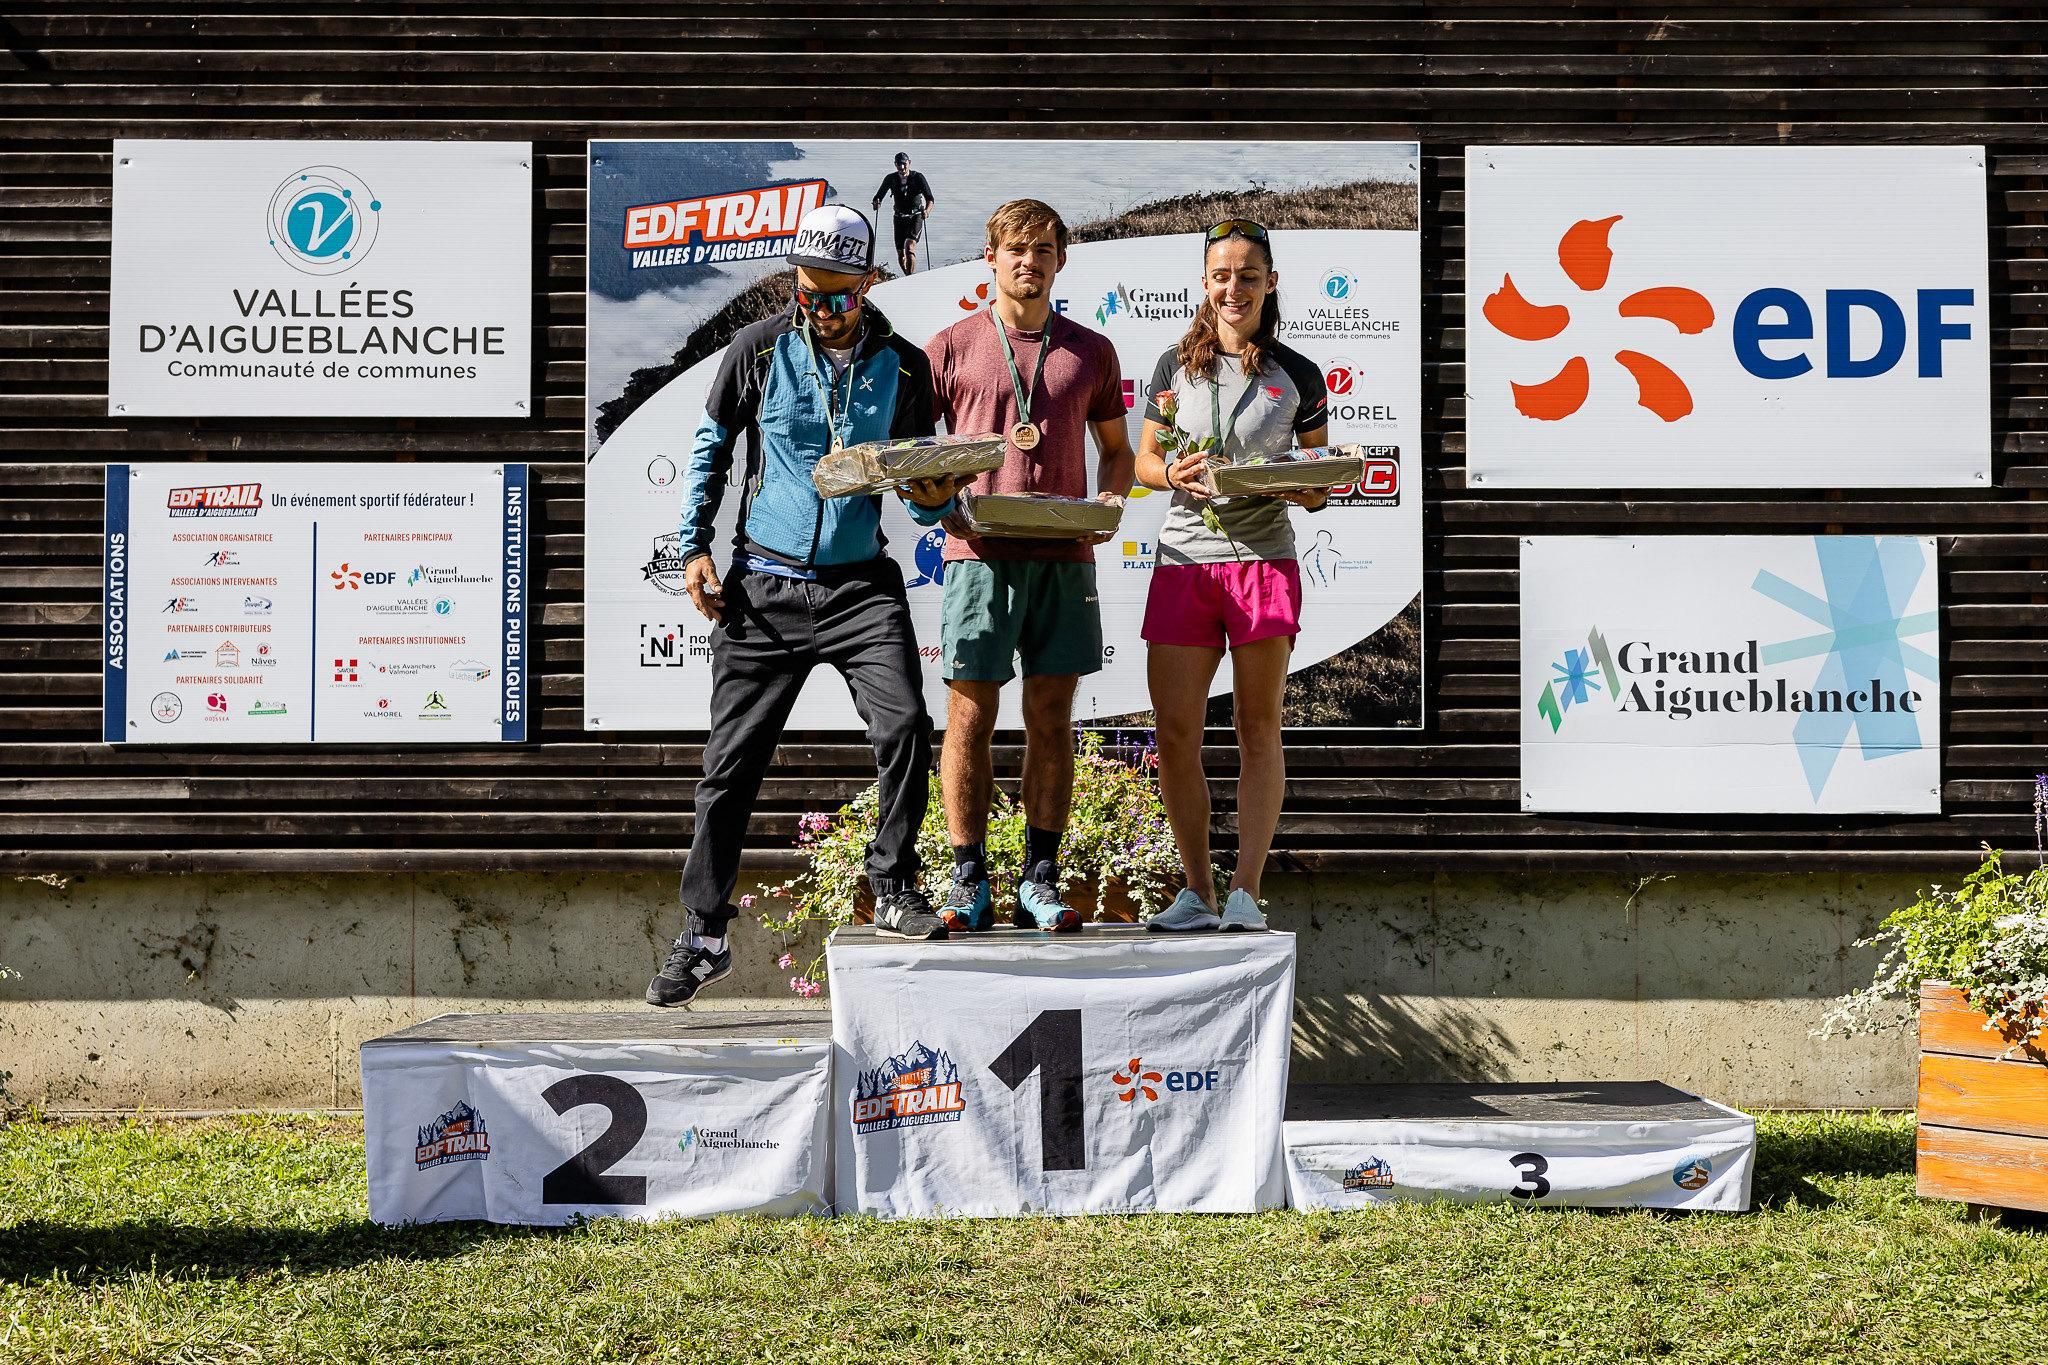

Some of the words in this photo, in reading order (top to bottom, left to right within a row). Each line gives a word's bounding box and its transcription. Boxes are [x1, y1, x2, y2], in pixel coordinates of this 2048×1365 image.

[626, 200, 701, 244] EDF
[798, 230, 866, 256] DYNAFIT
[632, 248, 690, 268] VALLEES
[695, 240, 797, 262] D'AIGUEBLAN
[233, 282, 414, 318] VALLÉES
[1130, 288, 1188, 302] Grand
[1130, 304, 1199, 321] Aiguebl
[1309, 307, 1369, 318] VALLÉES
[1279, 321, 1400, 331] D'AIGUEBLANCHE
[1733, 288, 1974, 380] eDF
[140, 325, 505, 355] D'AIGUEBLANCHE
[168, 360, 314, 378] Communauté
[323, 361, 349, 378] de
[357, 364, 476, 379] communes
[1328, 406, 1396, 420] MOREL
[170, 488, 206, 506] EDF
[205, 485, 260, 506] TRAIL
[272, 494, 286, 506] Un
[291, 493, 356, 506] événement
[360, 493, 400, 510] sportif
[404, 493, 466, 506] fédérateur
[171, 508, 198, 516] VALLEES
[199, 508, 256, 516] D'AIGUEBLANCHE
[172, 534, 218, 542] ASSOCIATION
[220, 534, 273, 542] ORGANISATRICE
[507, 487, 521, 613] INSTITUTIONS
[364, 572, 396, 584] eDF
[426, 566, 457, 574] Grand
[426, 575, 493, 584] Aigueblanche
[109, 533, 125, 669] ASSOCIATIONS
[690, 644, 714, 663] imp
[1618, 640, 1758, 674] Grand
[176, 676, 222, 684] PARTENAIRES
[224, 675, 263, 684] SOLIDARITÉ
[506, 618, 520, 722] PUBLIQUES
[1619, 679, 1922, 720] Aigueblanche
[988, 1009, 1085, 1171] 1
[1166, 1071, 1218, 1092] eDF
[856, 1095, 895, 1120] EDF
[896, 1084, 961, 1113] TRAIL
[860, 1120, 889, 1133] VALLEES
[892, 1112, 958, 1127] D'AIGUEBLANCHE
[541, 1074, 648, 1205] 2
[700, 1129, 737, 1138] Grand
[700, 1139, 779, 1149] Aigueblanche
[418, 1140, 445, 1161] EDF
[446, 1134, 488, 1153] TRAIL
[420, 1158, 441, 1170] VALLEES
[1344, 1178, 1362, 1187] EDF
[1363, 1175, 1392, 1186] TRAIL
[1508, 1153, 1550, 1199] 3
